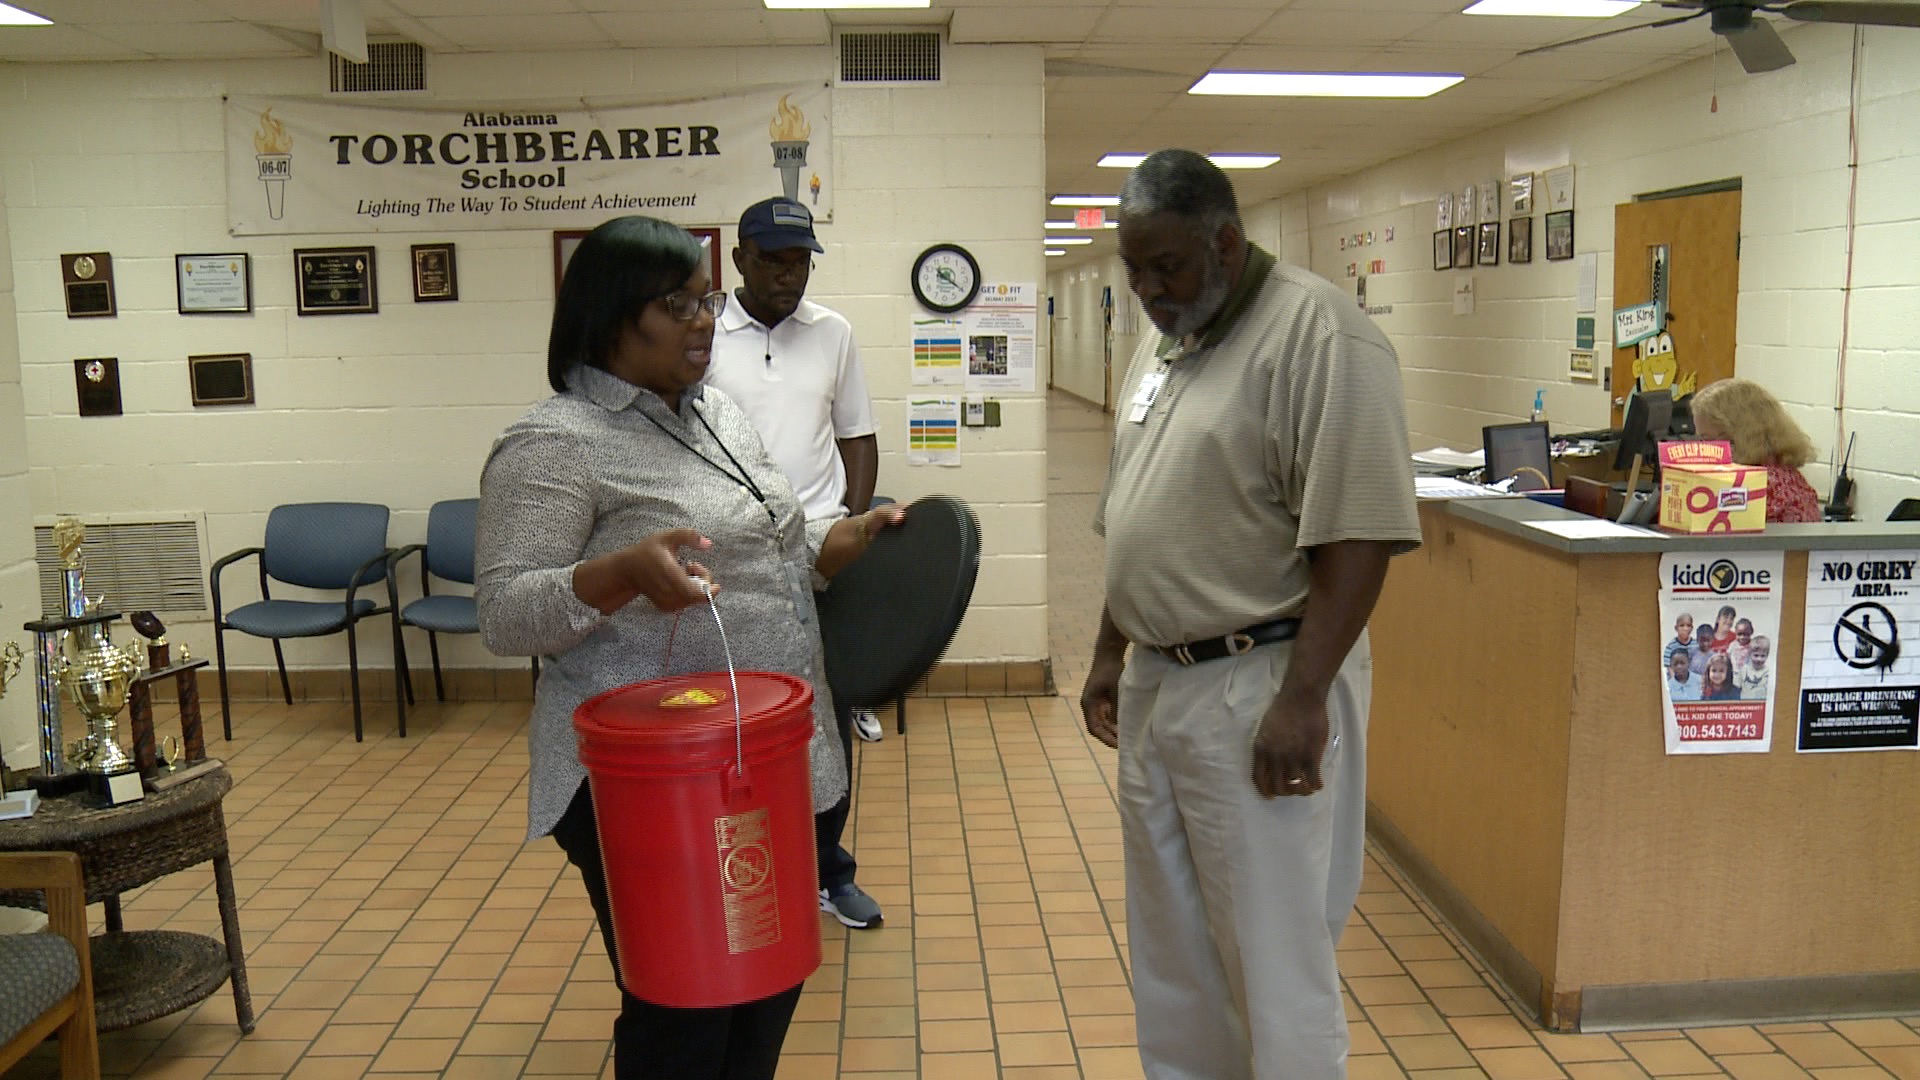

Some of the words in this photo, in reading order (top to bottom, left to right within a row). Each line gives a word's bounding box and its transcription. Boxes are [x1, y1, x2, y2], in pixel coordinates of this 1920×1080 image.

[463, 112, 558, 127] Alabama
[329, 125, 721, 165] TORCHBEARER
[776, 146, 803, 160] 07-08
[261, 160, 287, 174] 06-07
[461, 167, 566, 189] School
[357, 199, 420, 218] Lighting
[426, 197, 455, 214] The
[461, 196, 494, 215] Way
[500, 196, 518, 212] To
[523, 194, 587, 212] Student
[591, 193, 697, 210] Achievement
[981, 286, 996, 294] GET
[1010, 286, 1021, 294] FIT
[1636, 309, 1655, 323] King
[1667, 443, 1686, 461] EVERY
[1685, 443, 1699, 457] CLIP
[1821, 562, 1852, 581] NO
[1857, 561, 1916, 581] GREY
[1852, 583, 1908, 597] AREA...
[1808, 691, 1863, 703] UNDERAGE
[1864, 690, 1915, 701] DRINKING
[1821, 703, 1832, 713] IS
[1676, 712, 1690, 720] ALL
[1691, 712, 1705, 720] KID
[1707, 712, 1722, 720] ONE
[1725, 712, 1752, 720] TODAY!
